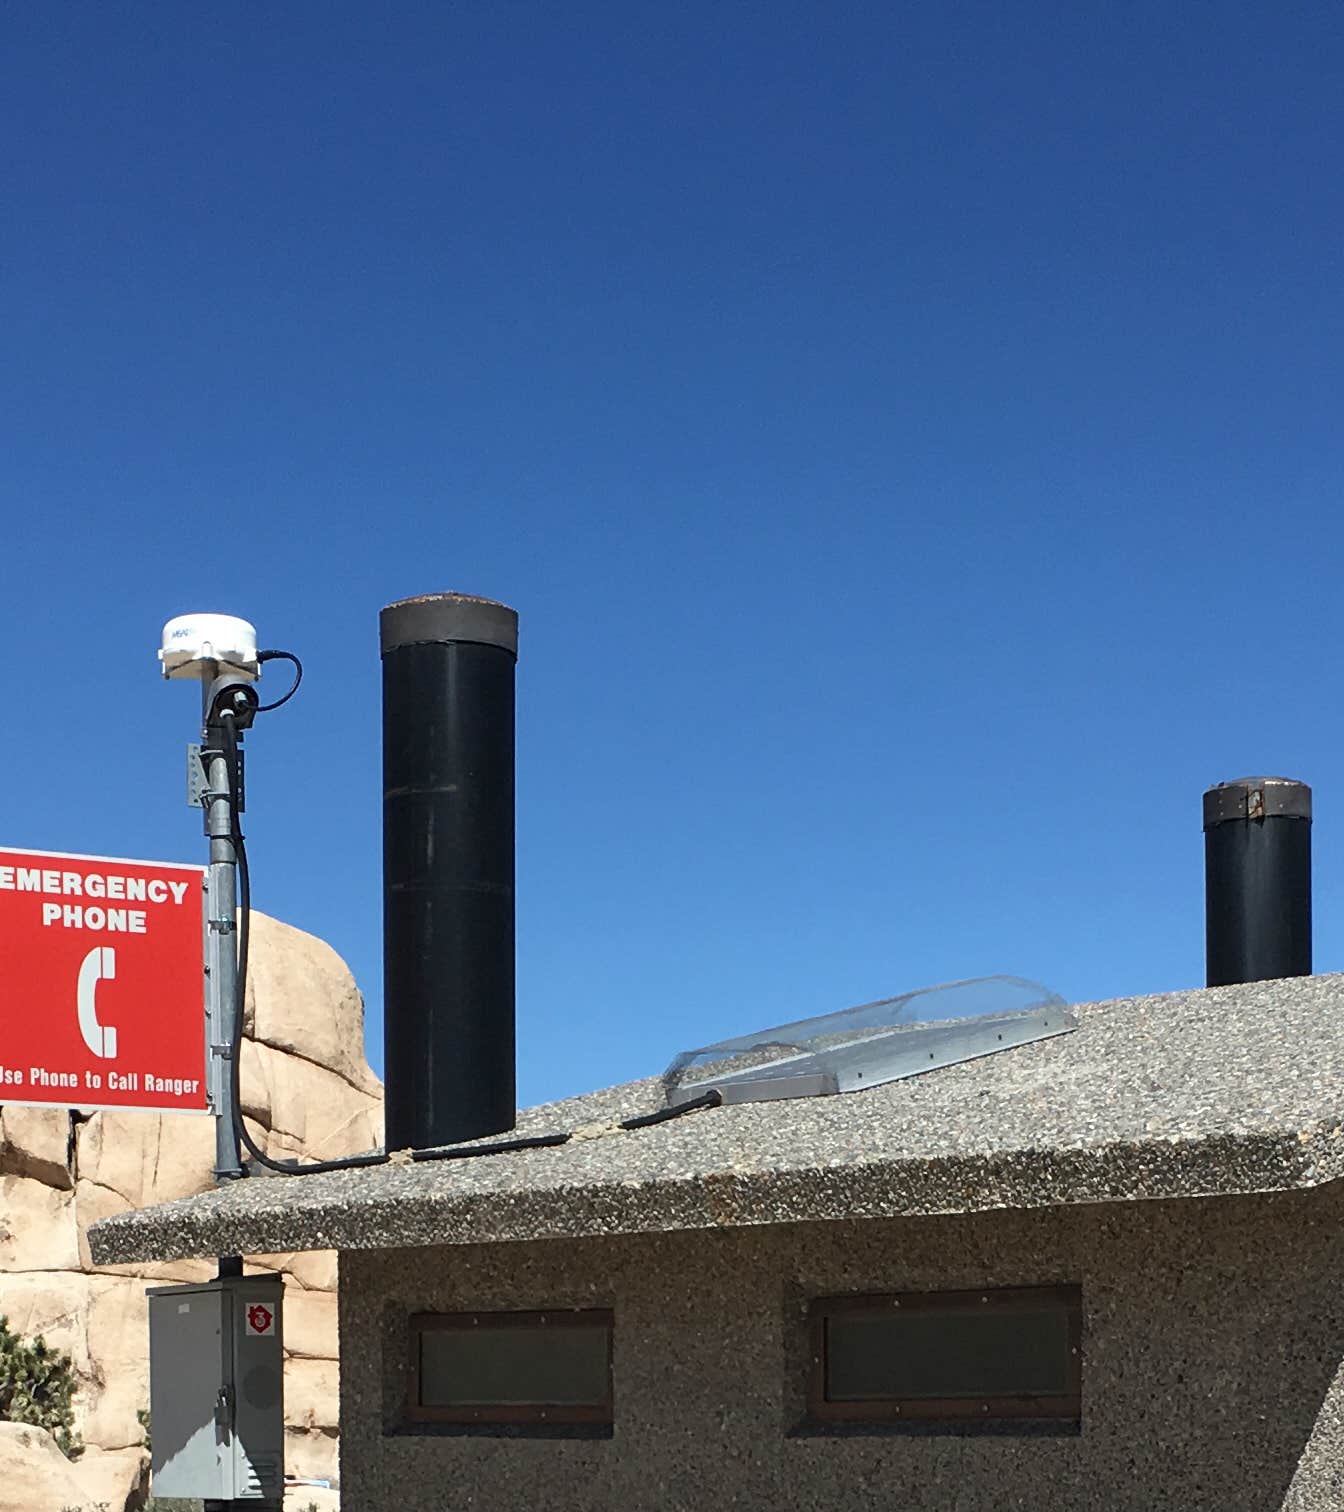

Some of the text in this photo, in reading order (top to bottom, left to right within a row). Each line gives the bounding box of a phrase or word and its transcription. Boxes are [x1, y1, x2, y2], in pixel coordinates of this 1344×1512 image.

[42, 902, 147, 934] PHONE
[29, 1067, 78, 1088] Phone
[84, 1070, 102, 1089] to
[108, 1071, 138, 1091] Call
[144, 1073, 200, 1096] Ranger
